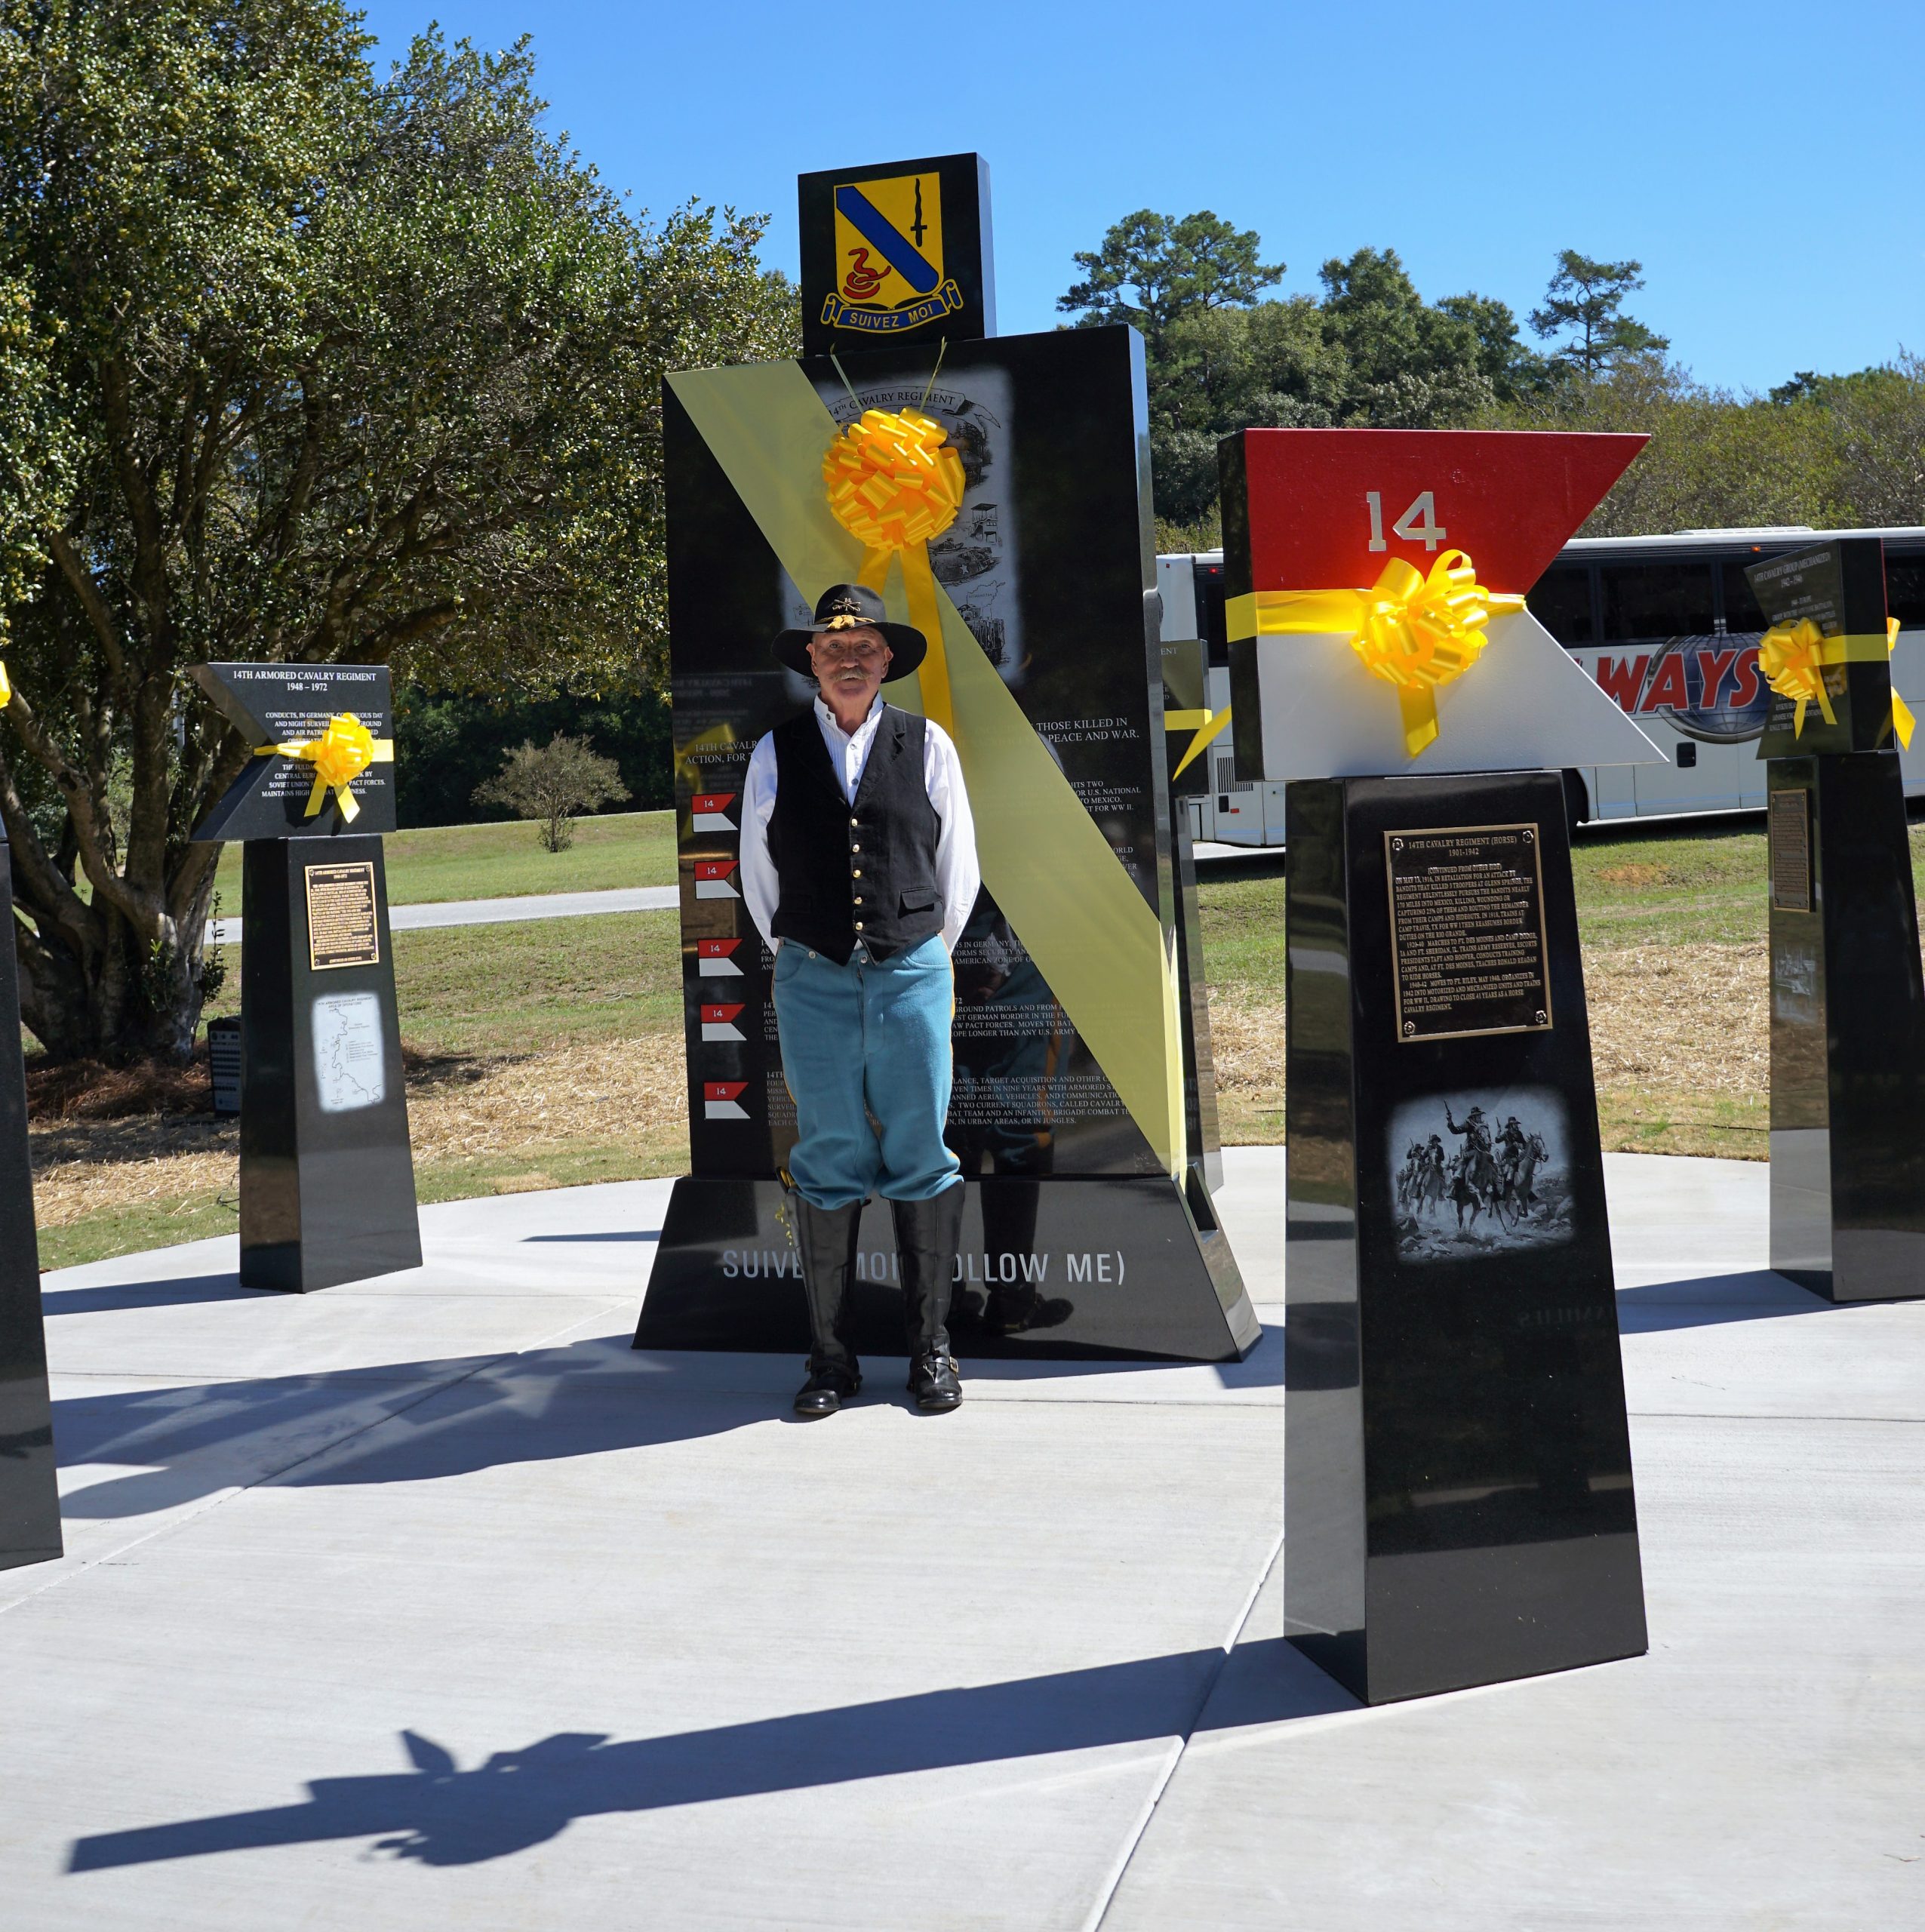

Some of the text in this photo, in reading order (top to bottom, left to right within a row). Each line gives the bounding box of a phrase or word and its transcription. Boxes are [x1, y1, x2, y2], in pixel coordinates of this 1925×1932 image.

[850, 304, 933, 328] SUIVEZ MOI
[849, 392, 894, 409] CAVALRY
[898, 392, 955, 405] REGIMENT
[1367, 491, 1447, 552] 14
[233, 670, 377, 681] 14TH ARMORED CAVALRY REGIMENT
[1594, 648, 1760, 713] WAYS
[287, 682, 303, 691] 1948
[311, 682, 328, 691] 1972
[266, 712, 299, 720] CONDUCTS,
[1036, 717, 1127, 731] THOSE KILLED IN
[1049, 729, 1139, 743] PEACE AND WAR.
[696, 740, 758, 752] 14TH CAVALR
[686, 753, 746, 764] ACTION, FOR
[1102, 787, 1141, 795] NATIONAL
[704, 800, 714, 808] 14
[1091, 796, 1122, 804] MEXICO.
[1409, 835, 1517, 849] 14TH CAVALRY REGIMENT (HORSE)
[1113, 846, 1133, 854] ORLD
[1449, 848, 1480, 857] 1901-1942
[707, 866, 717, 875] 14
[955, 957, 992, 965] AMERICAN
[986, 1004, 1017, 1013] PATROLS
[1037, 1003, 1057, 1011] FROM
[967, 1013, 998, 1021] GERMAN
[986, 1020, 1015, 1029] FORCES.
[1018, 1020, 1044, 1028] MOVES
[969, 1029, 997, 1038] LONGER
[1021, 1029, 1037, 1037] ANY
[1038, 1028, 1052, 1036] U.S.
[1054, 1027, 1075, 1035] ARMY
[1011, 1075, 1056, 1084] ACQUISITION
[1022, 1084, 1046, 1092] YEARS
[1069, 1083, 1105, 1091] ARMORED
[978, 1093, 1004, 1101] AERIAL
[1062, 1091, 1118, 1100] COMMUNICATIO
[958, 1101, 975, 1109] TWO
[976, 1101, 1010, 1109] CURRENT
[1012, 1100, 1058, 1109] SQUADRONS,
[1059, 1100, 1089, 1108] CALLED
[1015, 1108, 1052, 1117] INFANTRY
[1053, 1108, 1086, 1116] BRIGADE
[1087, 1107, 1120, 1115] COMBAT
[994, 1117, 1020, 1125] AREAS,
[722, 1249, 804, 1279] SUIVE
[952, 1252, 1048, 1282] OLLOW
[1066, 1251, 1125, 1285] ME)
